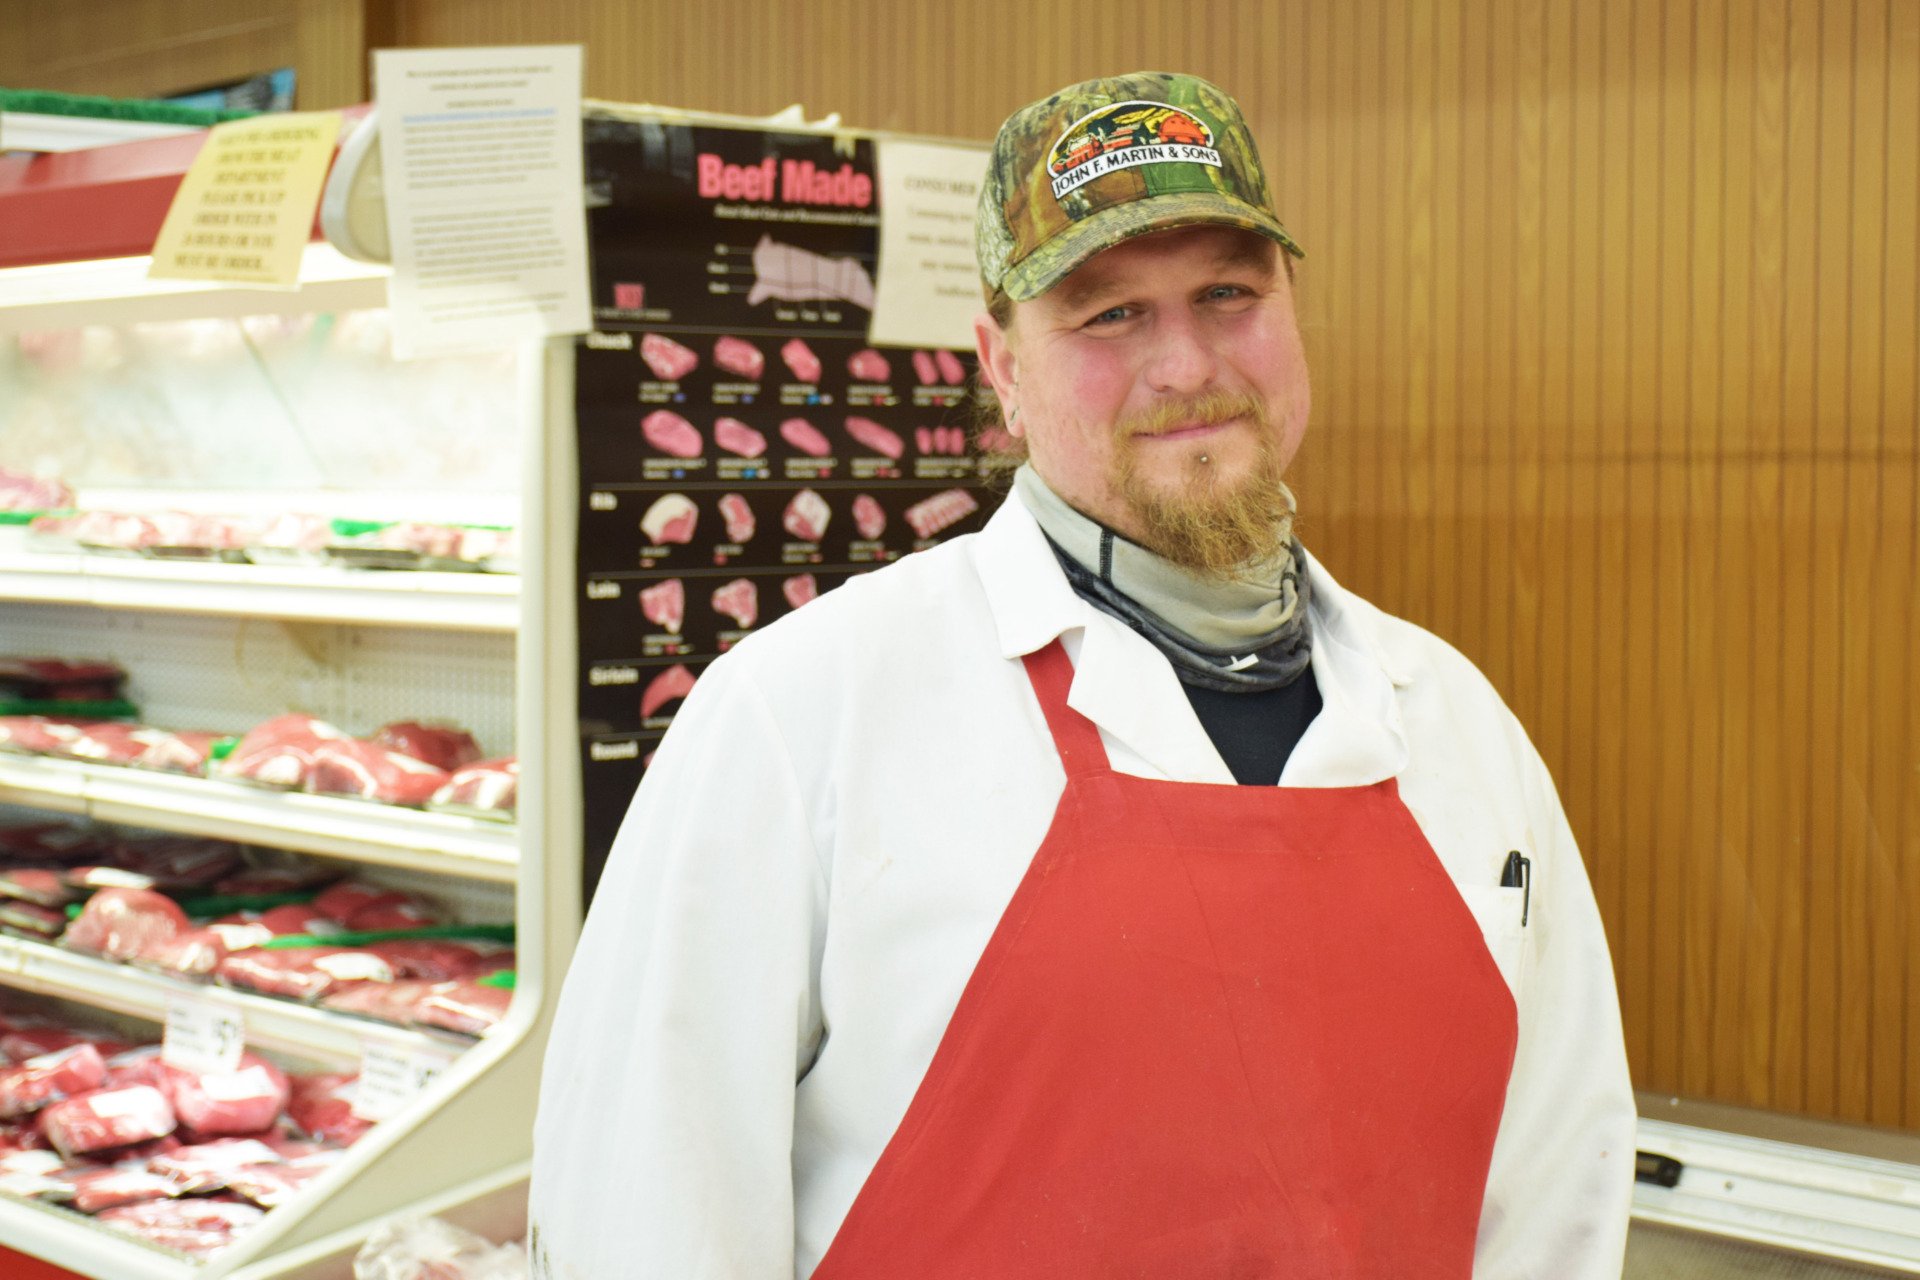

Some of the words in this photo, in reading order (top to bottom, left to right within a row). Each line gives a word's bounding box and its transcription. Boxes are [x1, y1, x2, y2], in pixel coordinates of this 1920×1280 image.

[697, 153, 777, 202] Beef
[781, 159, 872, 208] Made
[1055, 164, 1090, 195] JOHN
[1094, 162, 1103, 174] F.
[1107, 146, 1164, 169] MARTIN
[1168, 146, 1179, 158] &
[1183, 147, 1218, 162] SONS
[586, 332, 632, 350] Chuck
[590, 491, 617, 510] Rib
[587, 580, 621, 599] Loin
[589, 666, 639, 686] Sirloin
[591, 740, 638, 761] Round
